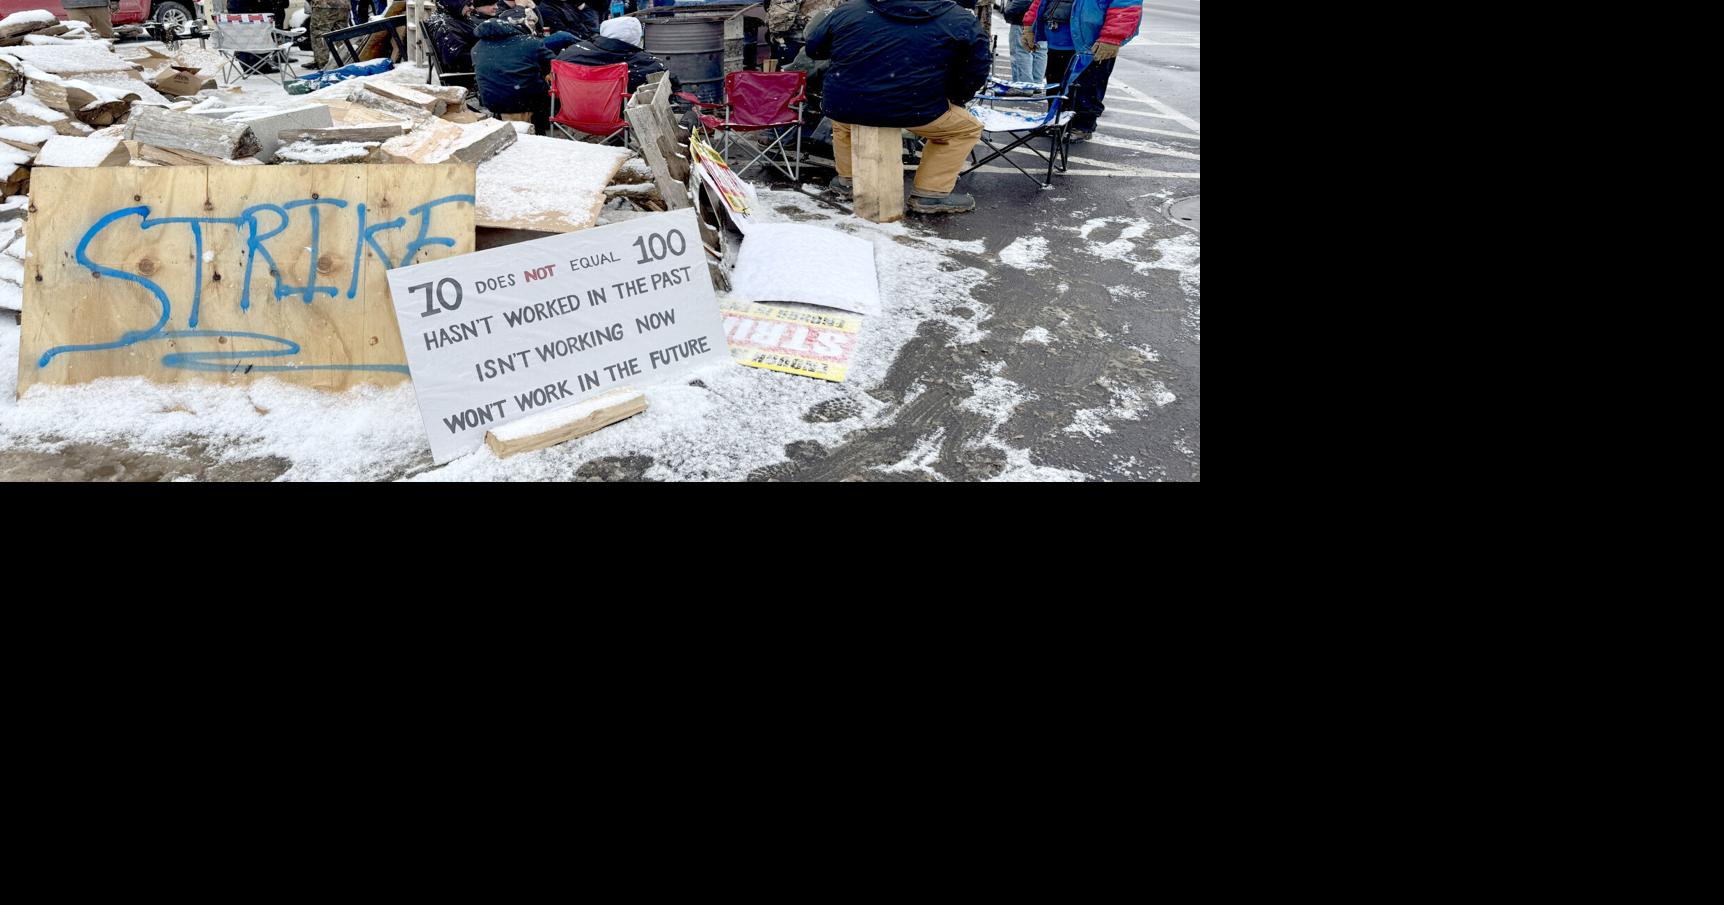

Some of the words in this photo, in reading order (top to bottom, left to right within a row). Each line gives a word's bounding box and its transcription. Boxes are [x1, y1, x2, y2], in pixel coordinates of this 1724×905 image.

[38, 194, 475, 367] STRIKE
[408, 277, 463, 317] 70
[475, 273, 516, 294] DOES
[524, 264, 556, 283] NOT
[570, 251, 621, 271] EQUAL
[632, 228, 686, 265] 100
[423, 315, 493, 351] HASN'T
[503, 294, 581, 330] WORKED
[587, 287, 607, 307] IN
[612, 276, 648, 300] THE
[651, 265, 692, 290] PAST
[442, 400, 507, 435] WON'T
[514, 380, 572, 413] WORK
[577, 370, 600, 392] IN
[603, 358, 642, 383] THE
[649, 336, 711, 370] FUTURE
[475, 349, 531, 382] ISN'T
[535, 322, 624, 363] WORKING
[635, 308, 676, 334] NOW
